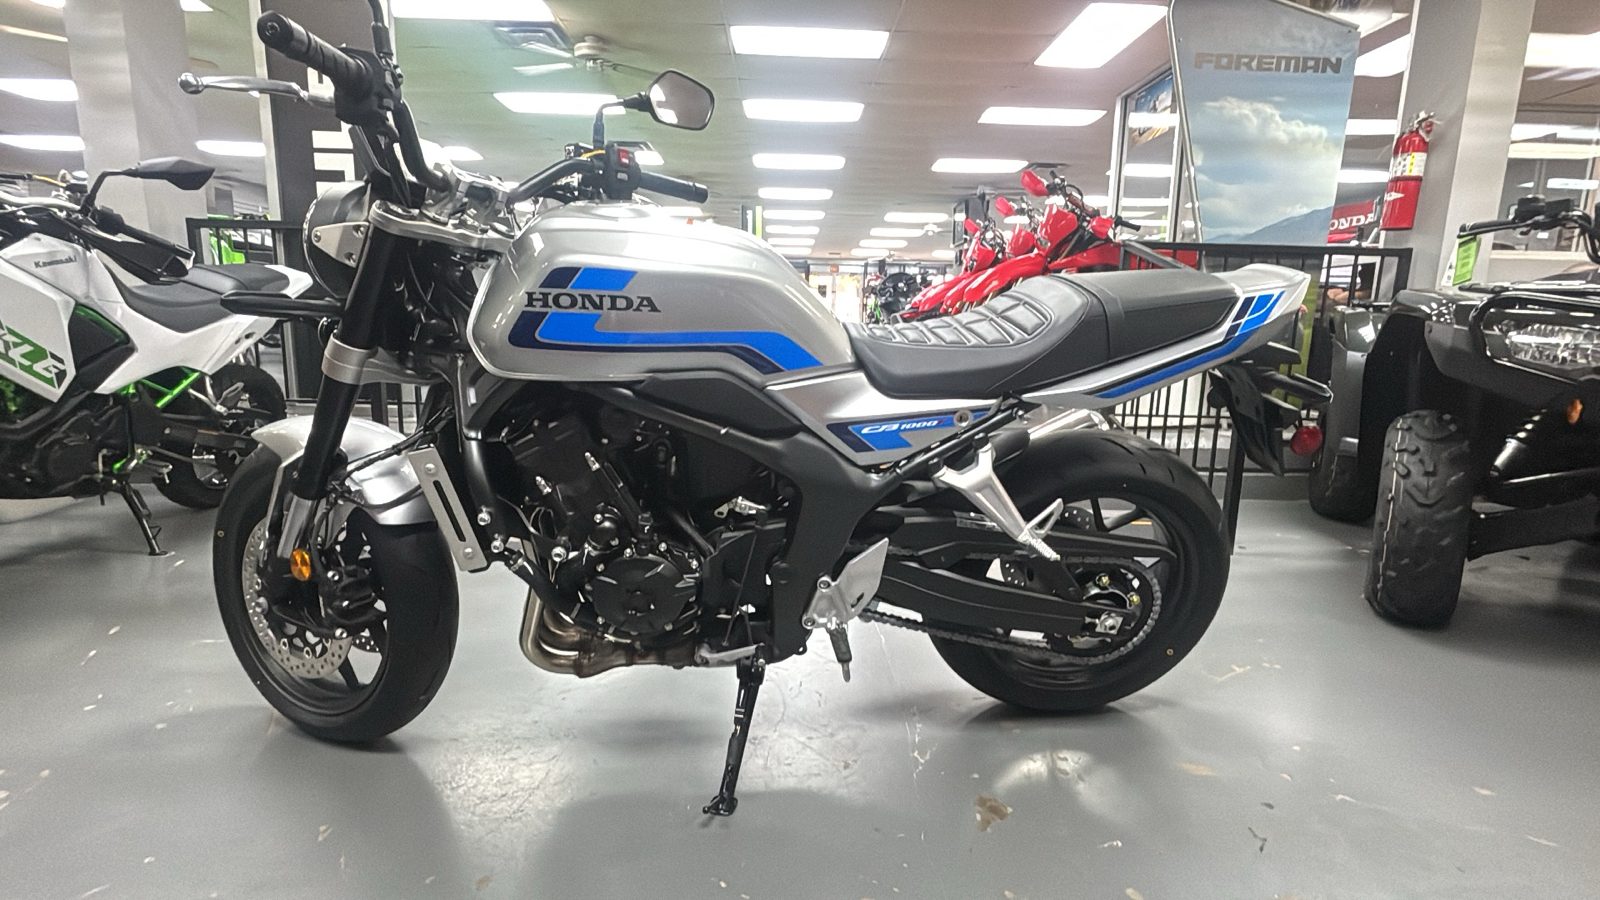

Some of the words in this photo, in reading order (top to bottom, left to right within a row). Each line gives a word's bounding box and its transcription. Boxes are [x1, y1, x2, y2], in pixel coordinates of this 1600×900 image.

[1194, 52, 1342, 74] FOREMAN
[1329, 213, 1375, 231] ONDA
[524, 291, 662, 313] HONDA
